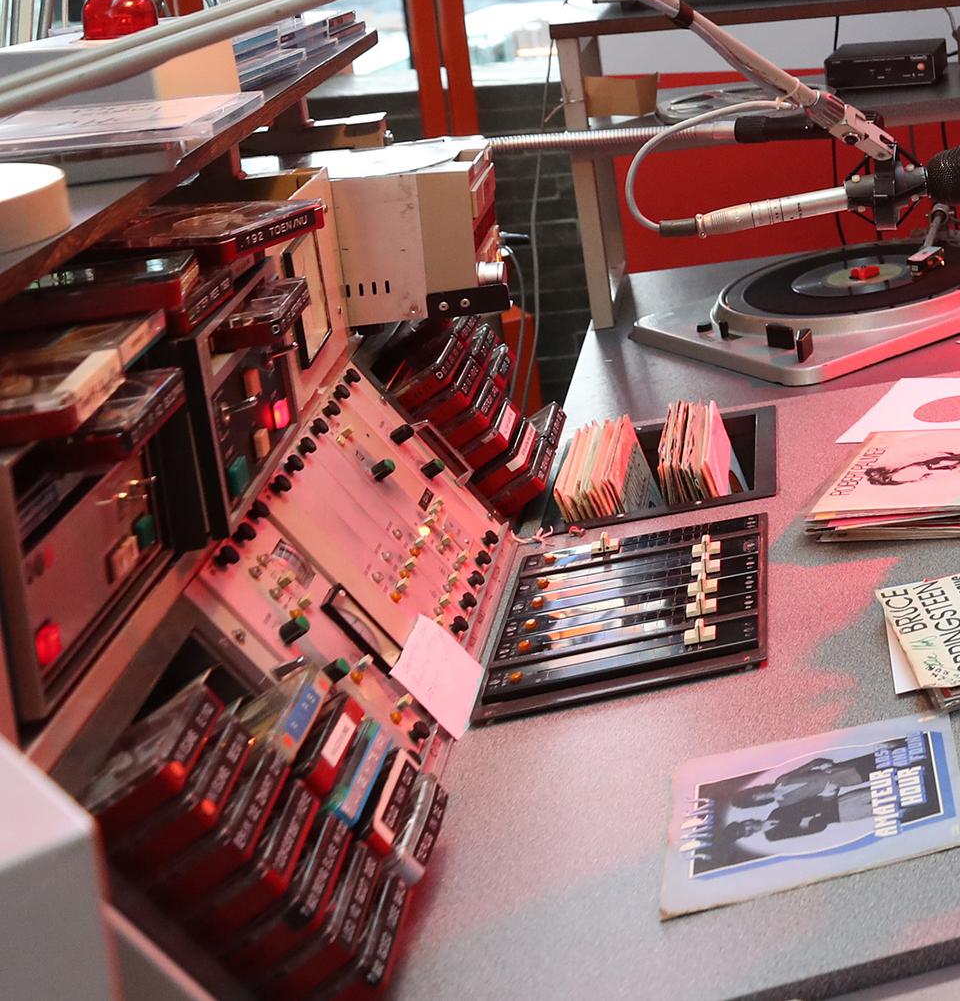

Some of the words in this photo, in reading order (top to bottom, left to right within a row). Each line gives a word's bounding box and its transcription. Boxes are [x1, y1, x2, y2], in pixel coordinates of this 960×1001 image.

[881, 589, 928, 635] BRUCE
[869, 767, 900, 837] AMATEUR
[897, 766, 925, 807] HOUR
